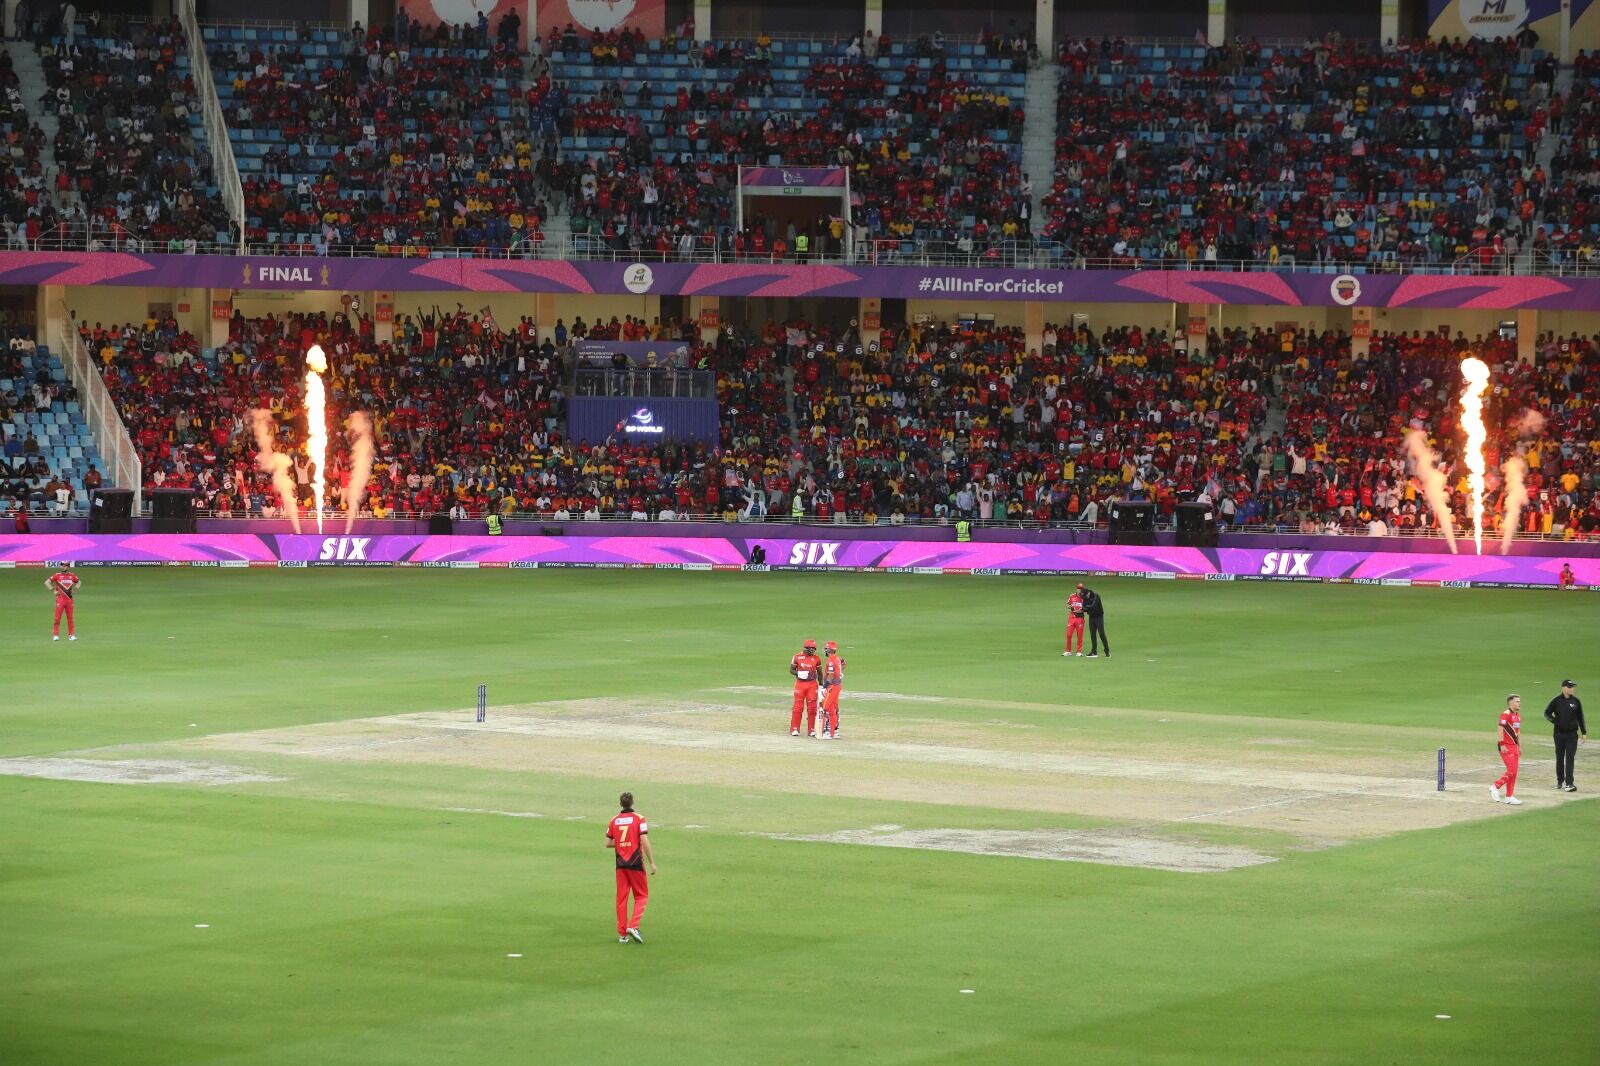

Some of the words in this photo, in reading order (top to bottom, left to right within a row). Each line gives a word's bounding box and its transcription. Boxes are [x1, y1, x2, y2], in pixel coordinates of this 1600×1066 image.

[259, 267, 313, 282] FINAL
[918, 277, 1064, 293] #AllInForCricket
[376, 311, 392, 320] 141
[1190, 324, 1206, 333] 142
[320, 537, 371, 560] SIX
[789, 542, 841, 565] SIX
[1261, 551, 1313, 575] SIX
[619, 825, 629, 842] 7
